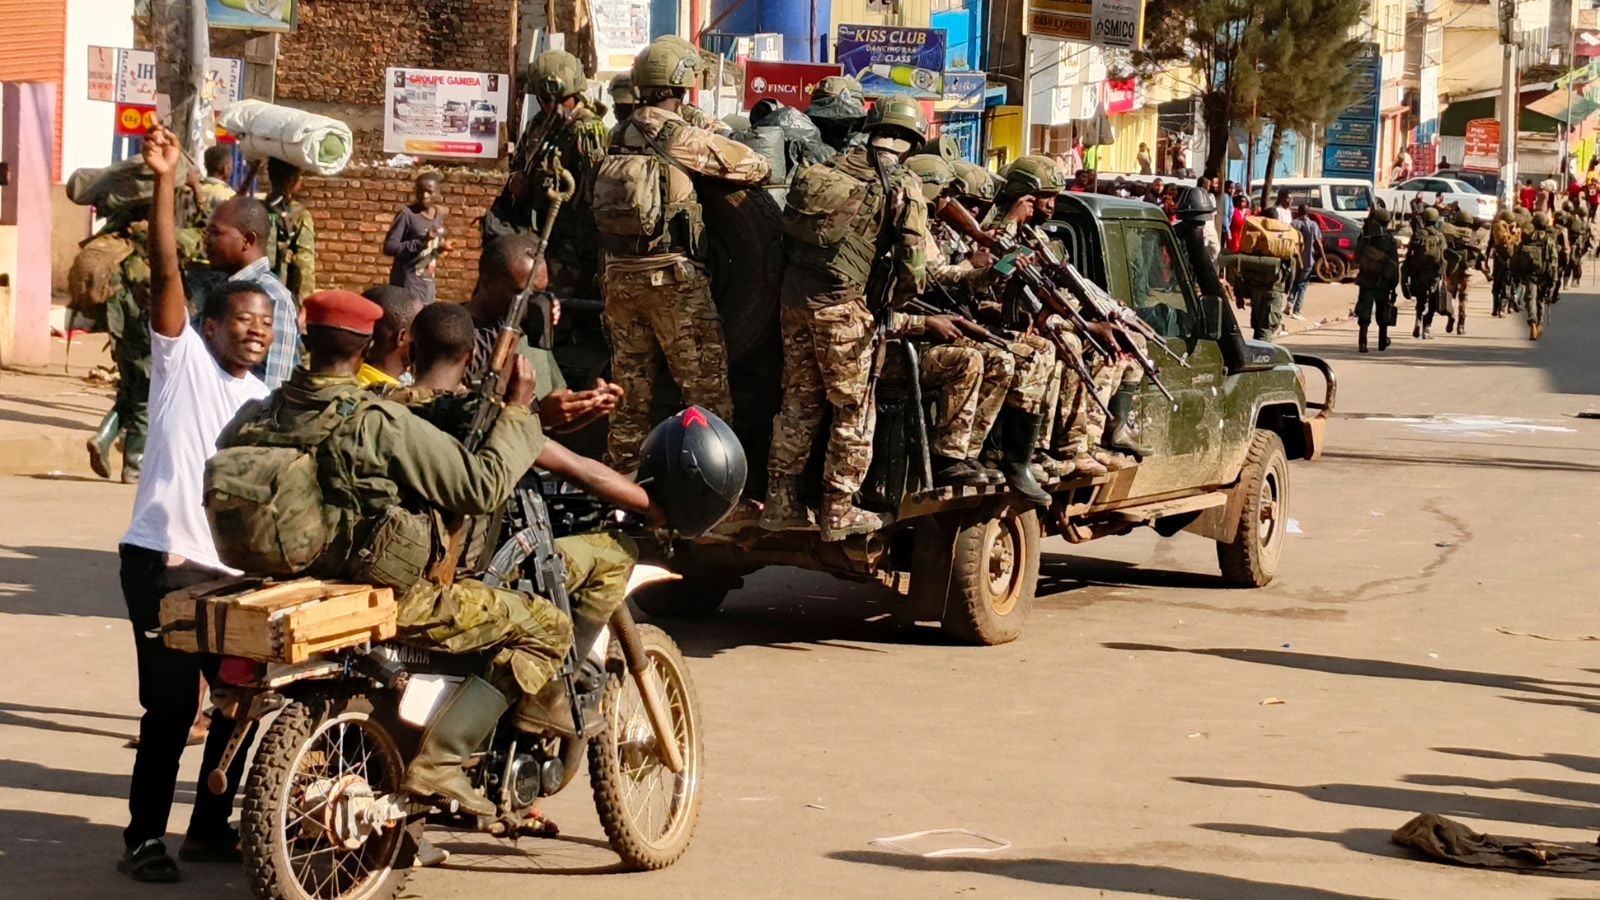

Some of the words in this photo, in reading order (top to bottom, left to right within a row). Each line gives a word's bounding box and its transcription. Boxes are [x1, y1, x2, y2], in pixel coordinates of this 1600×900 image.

[1103, 19, 1135, 38] SMICO
[855, 29, 886, 42] KISS
[889, 30, 927, 44] CLUB
[865, 45, 900, 53] DANCING
[884, 54, 911, 63] CLASS
[409, 75, 445, 85] GROUPE
[768, 84, 797, 94] FINCA
